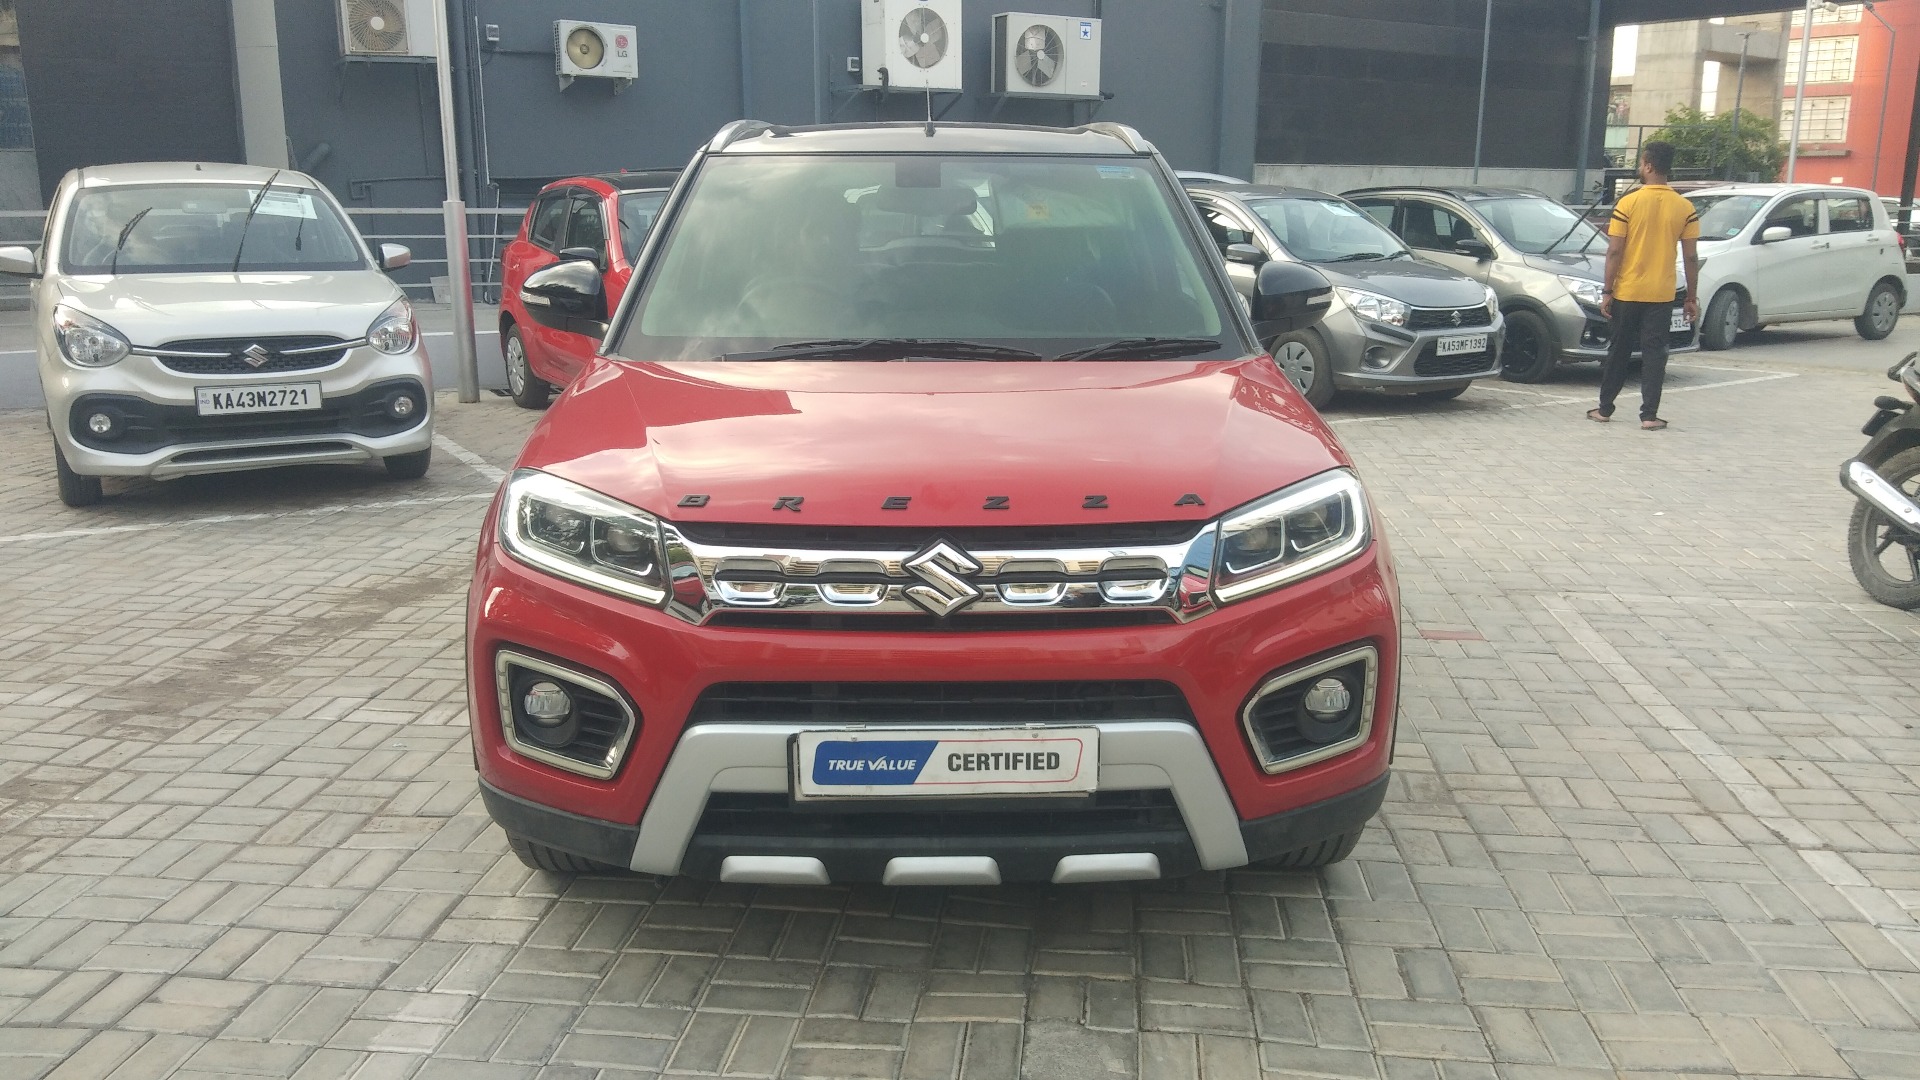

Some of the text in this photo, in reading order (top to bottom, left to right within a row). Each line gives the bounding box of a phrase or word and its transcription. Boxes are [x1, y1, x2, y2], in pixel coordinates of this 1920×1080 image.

[1442, 338, 1486, 352] KA53MF1392
[213, 389, 307, 409] KA43N2721
[676, 493, 1206, 512] BREZZA
[828, 751, 1060, 772] TRUE VALUE CERTIFIED
